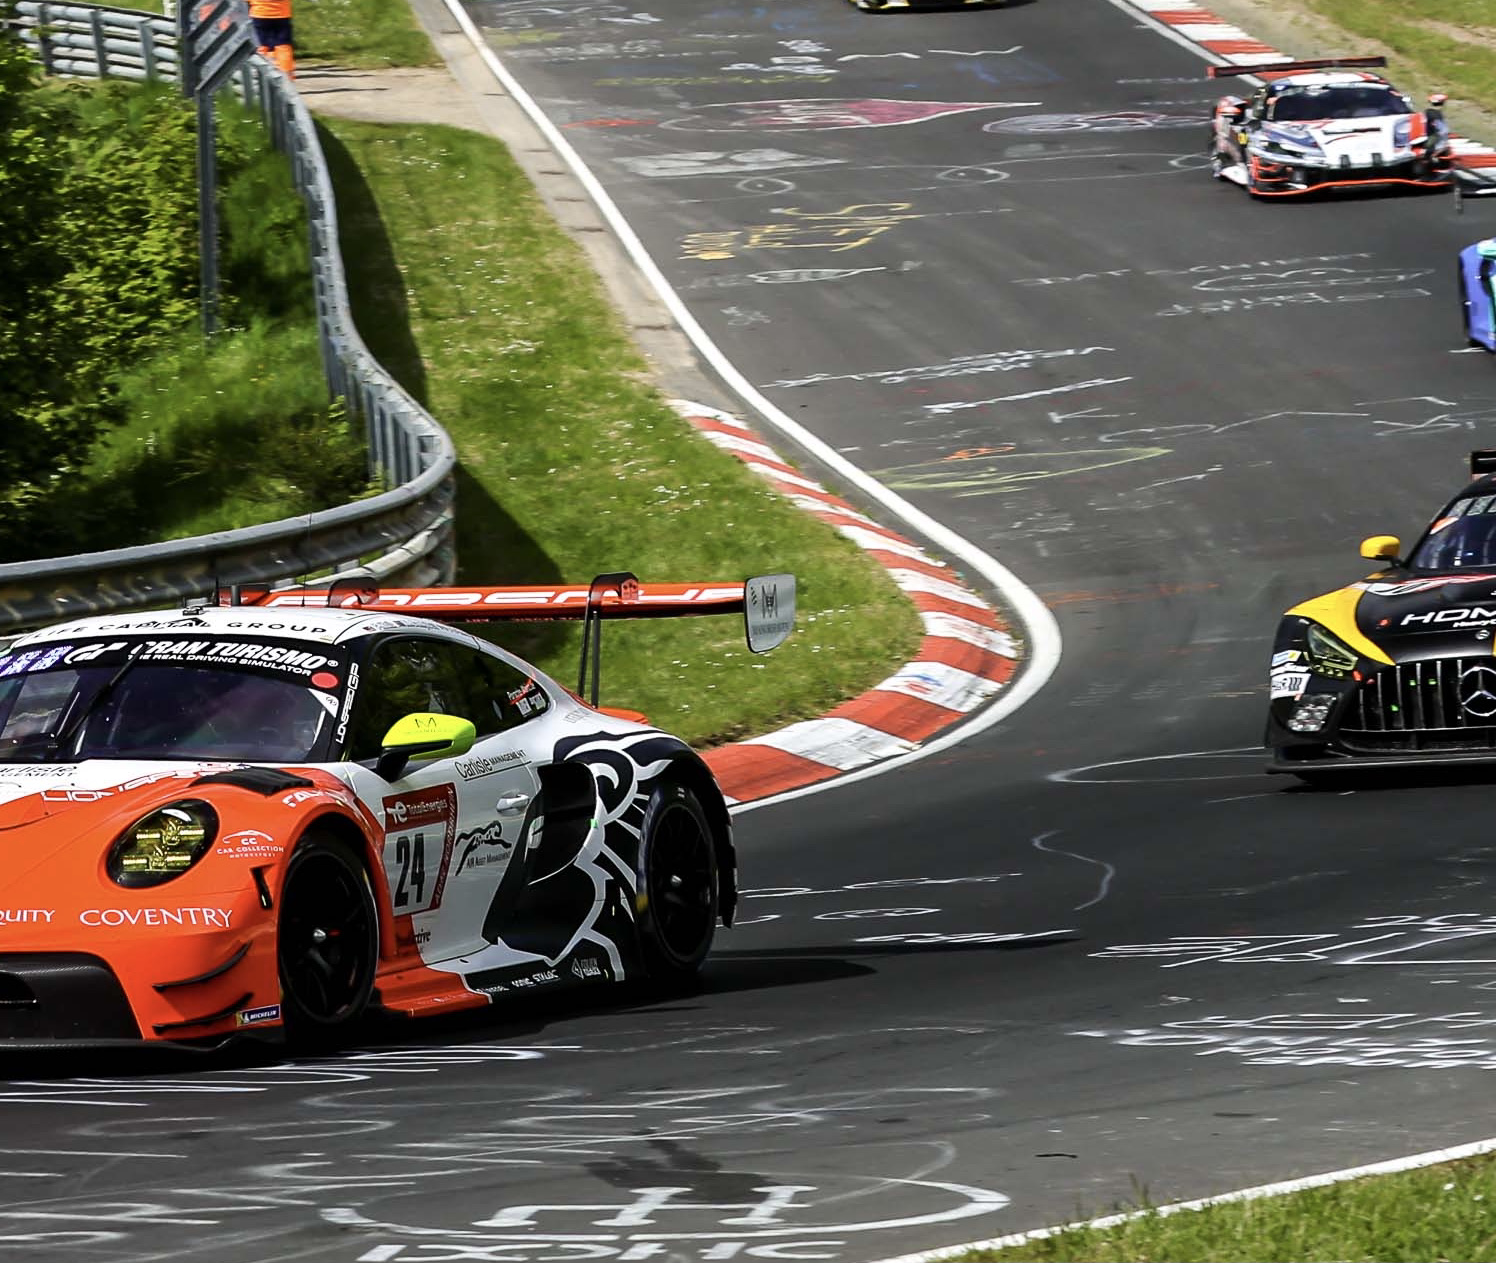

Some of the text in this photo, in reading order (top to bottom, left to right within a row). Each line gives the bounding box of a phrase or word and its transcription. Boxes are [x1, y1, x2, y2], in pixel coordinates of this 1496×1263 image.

[227, 621, 327, 634] GROUP
[186, 655, 237, 664] DRIVING
[239, 657, 313, 677] SIMULATOR
[347, 662, 360, 689] GP
[455, 749, 527, 779] Carlisle MANAGEMENT
[406, 797, 448, 815] TotalEnergies
[236, 845, 284, 853] COLLECTION
[394, 832, 425, 908] 24
[79, 907, 233, 928] COVENTRY
[250, 1009, 278, 1022] MICHELIN
